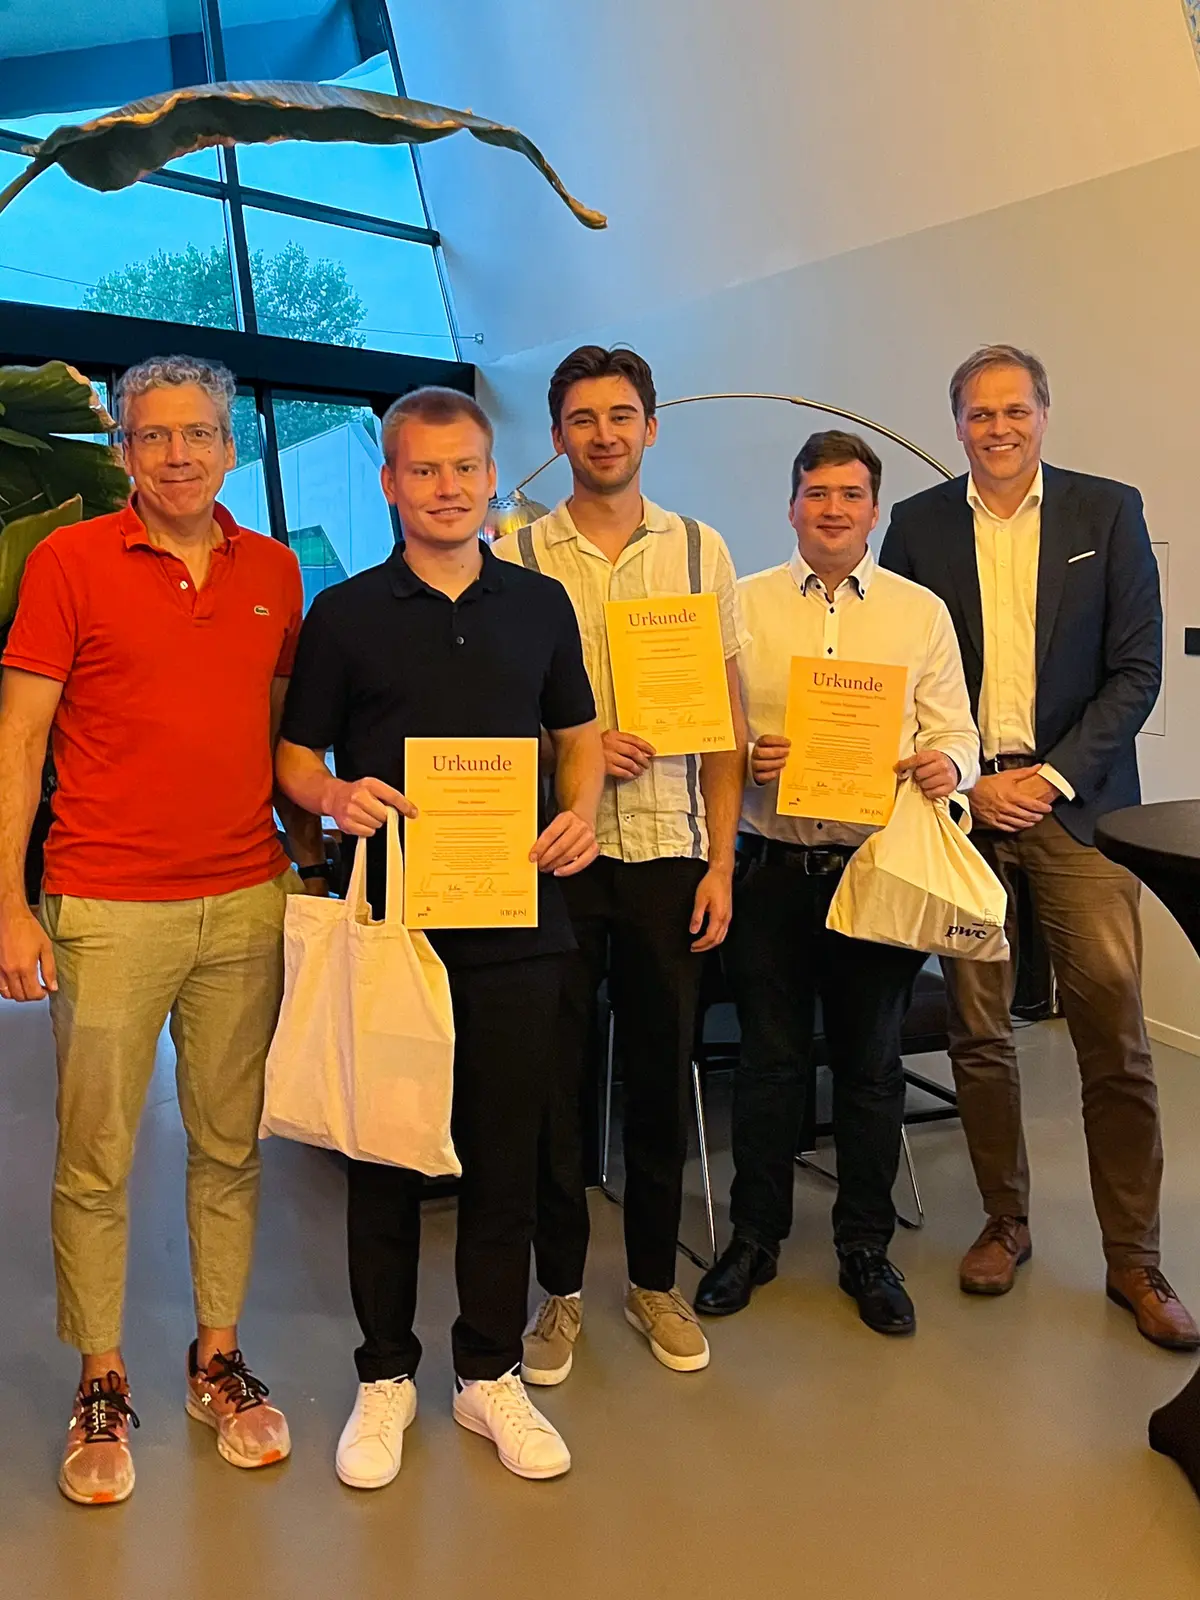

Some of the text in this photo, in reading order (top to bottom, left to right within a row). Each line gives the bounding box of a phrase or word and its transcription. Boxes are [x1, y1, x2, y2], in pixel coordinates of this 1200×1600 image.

[628, 608, 697, 627] Urkunde
[812, 672, 883, 692] Urkunde
[432, 754, 513, 771] Urkunde
[944, 924, 987, 940] pwc
